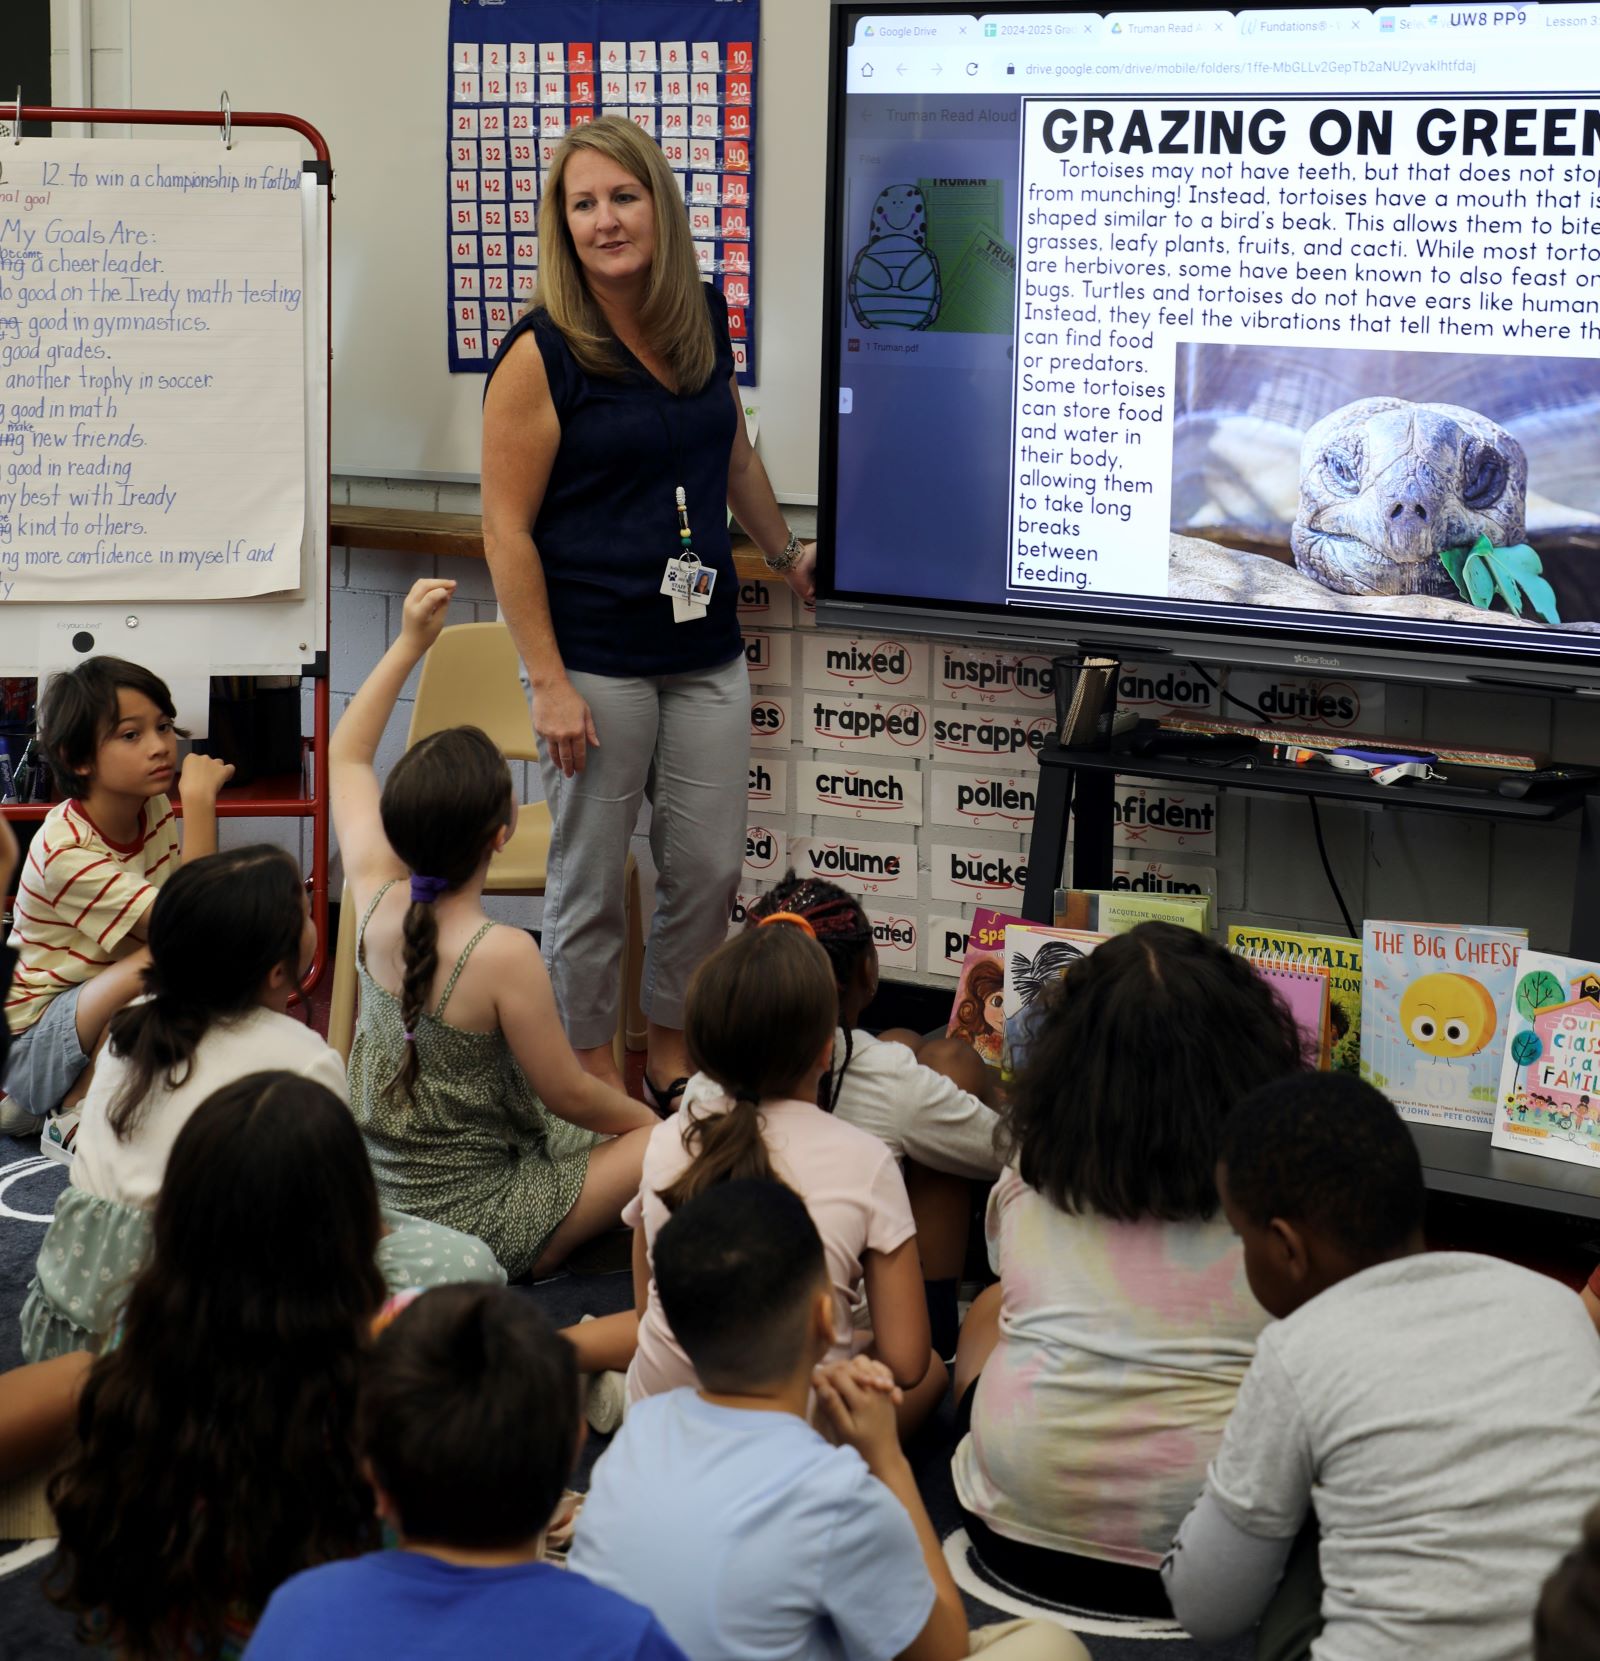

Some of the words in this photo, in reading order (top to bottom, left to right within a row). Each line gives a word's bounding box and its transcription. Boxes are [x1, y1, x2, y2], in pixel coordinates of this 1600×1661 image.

[879, 27, 911, 36] Google
[914, 27, 937, 35] Drive
[1001, 26, 1052, 35] 2024-2025
[1129, 24, 1161, 33] Truman
[1164, 24, 1193, 33] Read
[1451, 12, 1487, 26] UW8
[1493, 12, 1527, 26] PP9
[1546, 16, 1587, 27] Lesson
[463, 52, 468, 63] 1
[491, 52, 498, 64] 2
[518, 52, 526, 64] 3
[546, 52, 554, 63] 4
[577, 51, 585, 64] 5
[608, 51, 617, 62] 6
[639, 50, 646, 62] 7
[669, 50, 677, 62] 8
[701, 51, 709, 63] 9
[733, 51, 747, 65] 10
[461, 81, 471, 93] 11
[488, 81, 499, 94] 12
[515, 82, 527, 94] 13
[545, 82, 557, 95] 14
[576, 82, 589, 95] 15
[608, 82, 619, 93] 16
[635, 82, 647, 94] 17
[667, 82, 680, 94] 18
[697, 82, 709, 94] 19
[731, 82, 747, 96] 20
[887, 107, 936, 123] Truman
[941, 107, 975, 123] Read
[979, 107, 1017, 123] Aloud
[1043, 108, 1286, 155] GRAZING
[1309, 109, 1392, 156] ON
[43, 161, 64, 186] 12.
[69, 163, 88, 187] to
[96, 174, 124, 186] win
[130, 175, 140, 187] a
[145, 164, 239, 193] championship
[244, 176, 257, 189] in
[1059, 159, 1144, 178] Tortoises
[1152, 166, 1194, 184] may
[1202, 162, 1233, 179] not
[1241, 161, 1289, 179] have
[1298, 162, 1355, 181] teeth,
[1365, 162, 1398, 180] but
[1408, 162, 1450, 181] that
[1459, 162, 1510, 182] does
[1520, 164, 1555, 182] not
[24, 192, 50, 211] goal
[1029, 183, 1073, 201] from
[1081, 185, 1180, 208] munching!
[1189, 185, 1269, 205] Instead,
[1279, 188, 1366, 206] tortoises
[1376, 187, 1426, 206] have
[1435, 194, 1447, 207] a
[1457, 189, 1526, 207] mouth
[1536, 189, 1581, 208] that
[458, 210, 470, 222] 51
[485, 212, 500, 224] 52
[514, 211, 529, 223] 53
[727, 216, 743, 229] 60
[0, 219, 36, 251] My
[45, 219, 105, 243] Goals
[109, 220, 156, 245] Are:
[32, 257, 43, 273] a
[49, 248, 164, 273] cheerleader.
[17, 279, 56, 308] good
[61, 286, 82, 301] on
[88, 278, 122, 302] the
[121, 277, 180, 314] Iredy
[187, 279, 232, 303] math
[237, 279, 301, 311] testing
[29, 307, 68, 338] good
[73, 312, 89, 331] in
[92, 305, 210, 338] gymnastics.
[1025, 332, 1057, 344] can
[1066, 328, 1101, 346] find
[1109, 329, 1153, 349] food
[1024, 356, 1043, 367] or
[1050, 353, 1147, 374] predators.
[3, 361, 71, 389] another
[79, 365, 133, 396] trophy
[140, 376, 153, 389] in
[159, 374, 213, 389] soccer.
[1023, 374, 1075, 393] Some
[1083, 378, 1165, 398] tortoises
[8, 396, 45, 427] good
[49, 405, 64, 418] in
[70, 396, 117, 418] math
[1022, 404, 1055, 416] can
[1064, 401, 1110, 419] store
[1118, 402, 1162, 422] food
[29, 428, 67, 447] new
[72, 422, 147, 448] friends.
[1022, 423, 1056, 440] and
[1064, 426, 1118, 443] water
[1126, 429, 1140, 444] in
[1021, 445, 1063, 464] their
[1071, 447, 1122, 472] body,
[1020, 469, 1096, 495] allowing
[1104, 474, 1152, 493] them
[20, 482, 61, 506] best
[69, 482, 112, 506] with
[118, 484, 176, 514] Iready
[1019, 493, 1036, 510] to
[1045, 495, 1083, 513] take
[1091, 496, 1131, 522] long
[18, 513, 56, 536] kind
[60, 512, 78, 536] to
[85, 513, 147, 535] others.
[1019, 515, 1080, 536] breaks
[26, 552, 61, 564] more
[67, 539, 153, 564] confidence
[160, 551, 173, 563] in
[179, 539, 244, 570] myself
[247, 544, 275, 561] and
[1018, 538, 1097, 561] between
[1017, 562, 1093, 590] feeding.
[827, 649, 904, 675] mixed
[945, 656, 1055, 693] inspiring
[1118, 673, 1210, 703] andon
[1258, 684, 1354, 719] duties
[814, 703, 919, 737] trapped
[816, 774, 903, 800] crunch
[958, 779, 1034, 810] pollen
[808, 846, 900, 874] volume
[951, 854, 1028, 885] bucke
[1108, 908, 1148, 918] JACQUELINE
[1151, 912, 1184, 922] WOODSON
[1372, 931, 1405, 955] THE
[1413, 934, 1446, 959] BIG
[1308, 947, 1362, 972] TALL
[1408, 1108, 1430, 1116] JOHN
[1444, 1112, 1463, 1121] PETE
